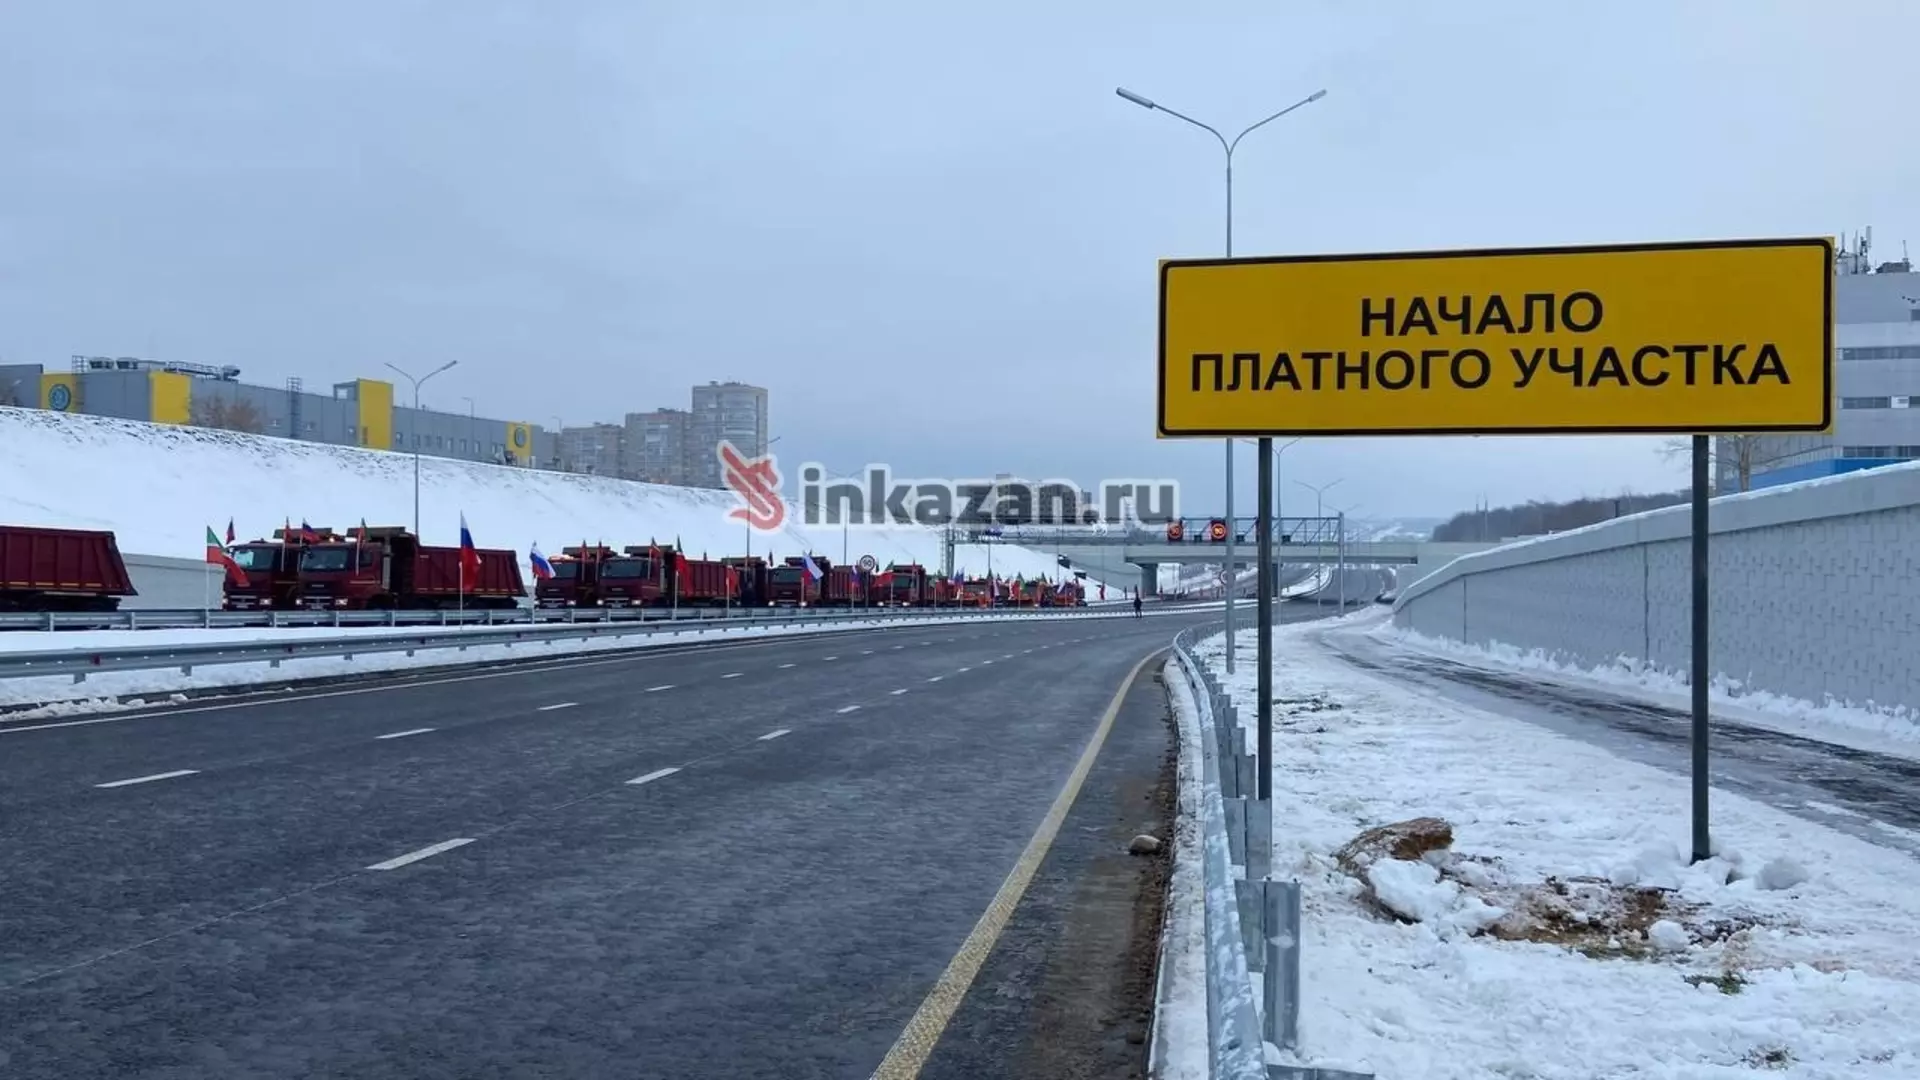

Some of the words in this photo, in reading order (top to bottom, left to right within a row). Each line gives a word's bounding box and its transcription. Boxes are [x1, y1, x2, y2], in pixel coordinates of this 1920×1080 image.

[1361, 291, 1603, 337] НАЧАЛО
[1192, 348, 1491, 392] ПЛАТНОГО
[1510, 343, 1791, 388] УЧАСТКА
